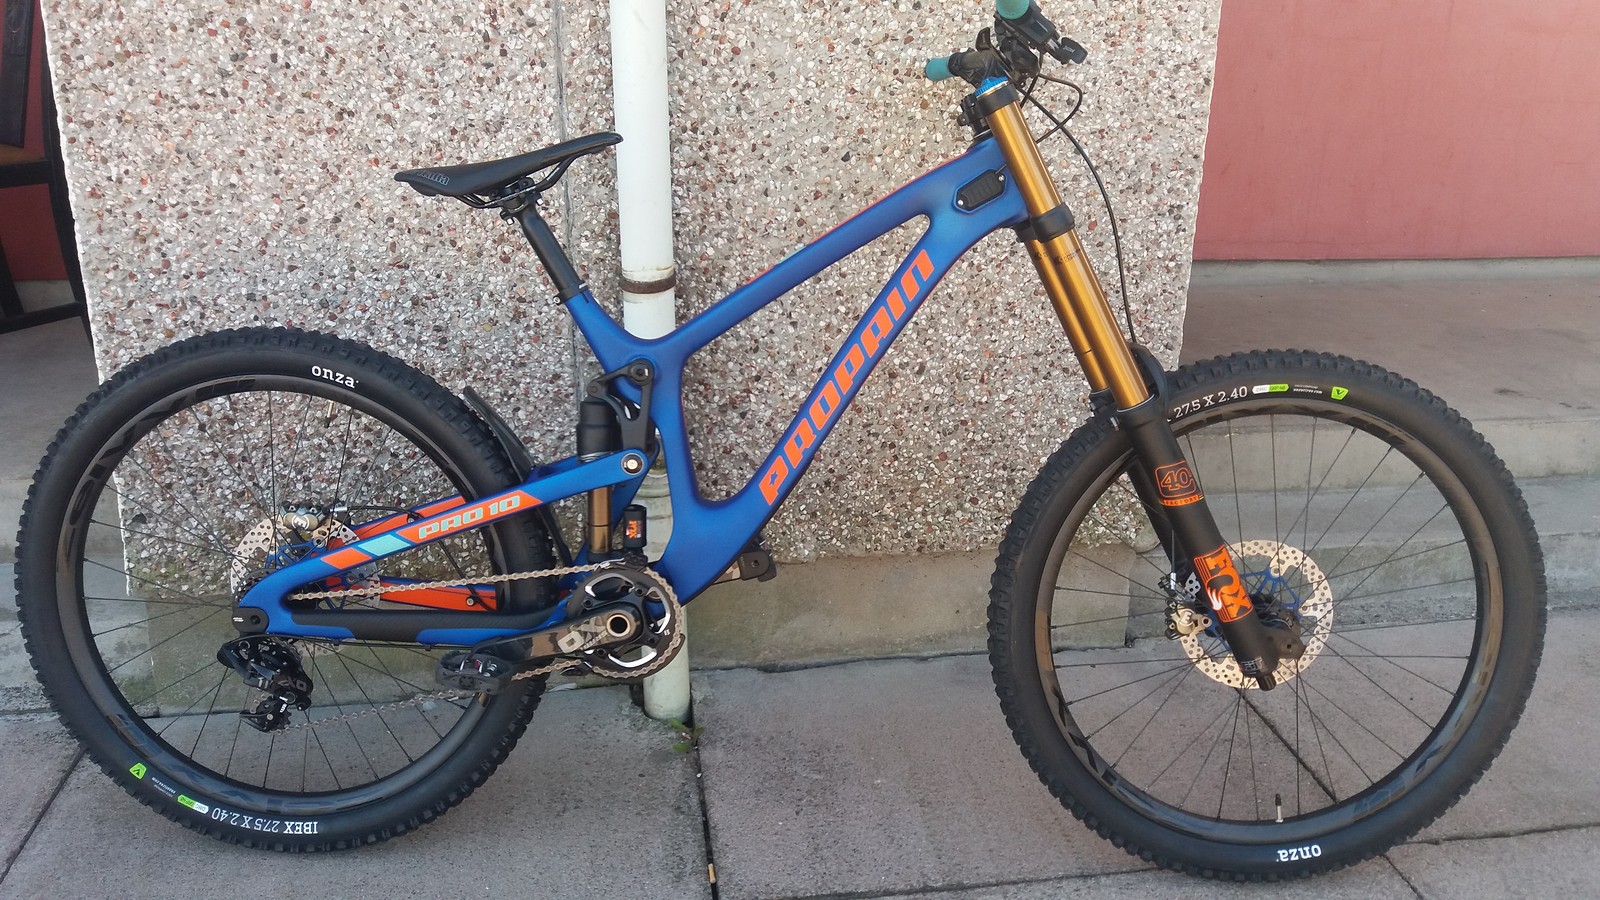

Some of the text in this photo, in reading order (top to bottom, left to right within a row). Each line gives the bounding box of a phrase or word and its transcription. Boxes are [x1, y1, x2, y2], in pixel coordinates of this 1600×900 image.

[311, 365, 356, 389] onza
[758, 249, 935, 506] PROPAIN
[1173, 399, 1202, 419] 27.5
[1217, 386, 1248, 404] 2.40
[1161, 467, 1193, 492] 40
[418, 495, 521, 539] PRO 10
[1203, 546, 1254, 620] FOX
[211, 807, 241, 826] 2.40
[253, 817, 281, 833] 27.5
[283, 821, 319, 835] IBEX
[1276, 844, 1322, 862] onza
